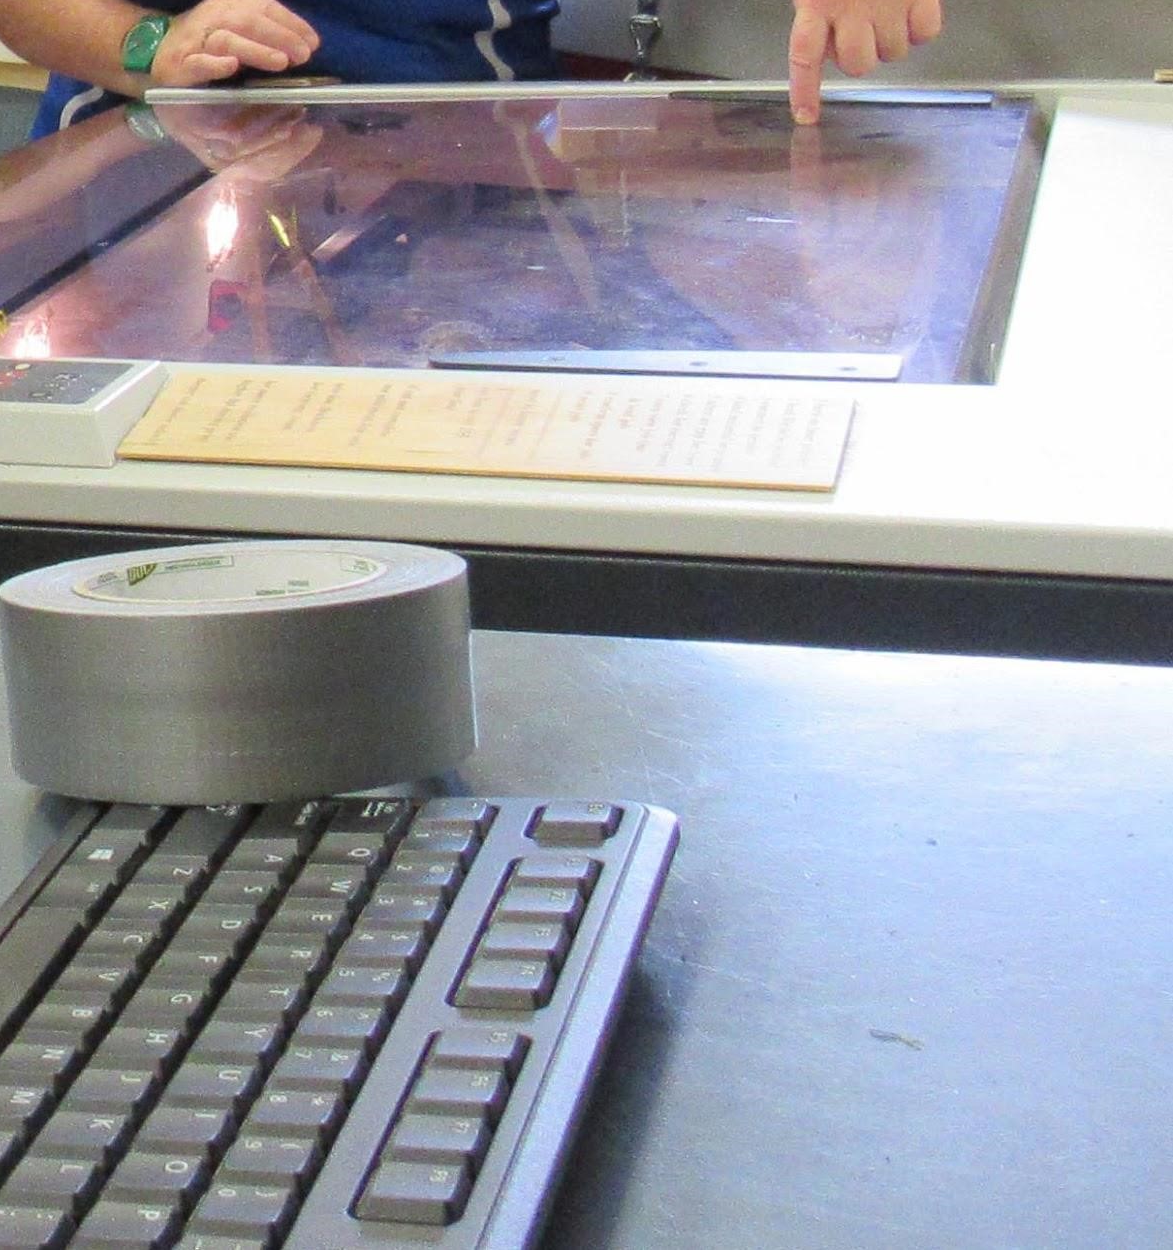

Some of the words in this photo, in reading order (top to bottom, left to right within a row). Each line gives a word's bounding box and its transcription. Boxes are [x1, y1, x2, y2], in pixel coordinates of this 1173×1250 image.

[172, 867, 194, 877] Z
[330, 879, 352, 893] W
[147, 900, 170, 910] X
[221, 919, 242, 929] D
[123, 934, 144, 944] C
[290, 949, 312, 960] R
[98, 971, 120, 982] V
[170, 993, 193, 1004] G
[71, 1008, 93, 1018] B
[146, 1030, 169, 1044] H
[244, 1027, 269, 1038] Y
[41, 1048, 65, 1060] N
[218, 1069, 242, 1081] U
[10, 1089, 36, 1104] M
[89, 1118, 115, 1130] K
[59, 1164, 84, 1174] L
[164, 1160, 189, 1173] O
[137, 1209, 161, 1220] P
